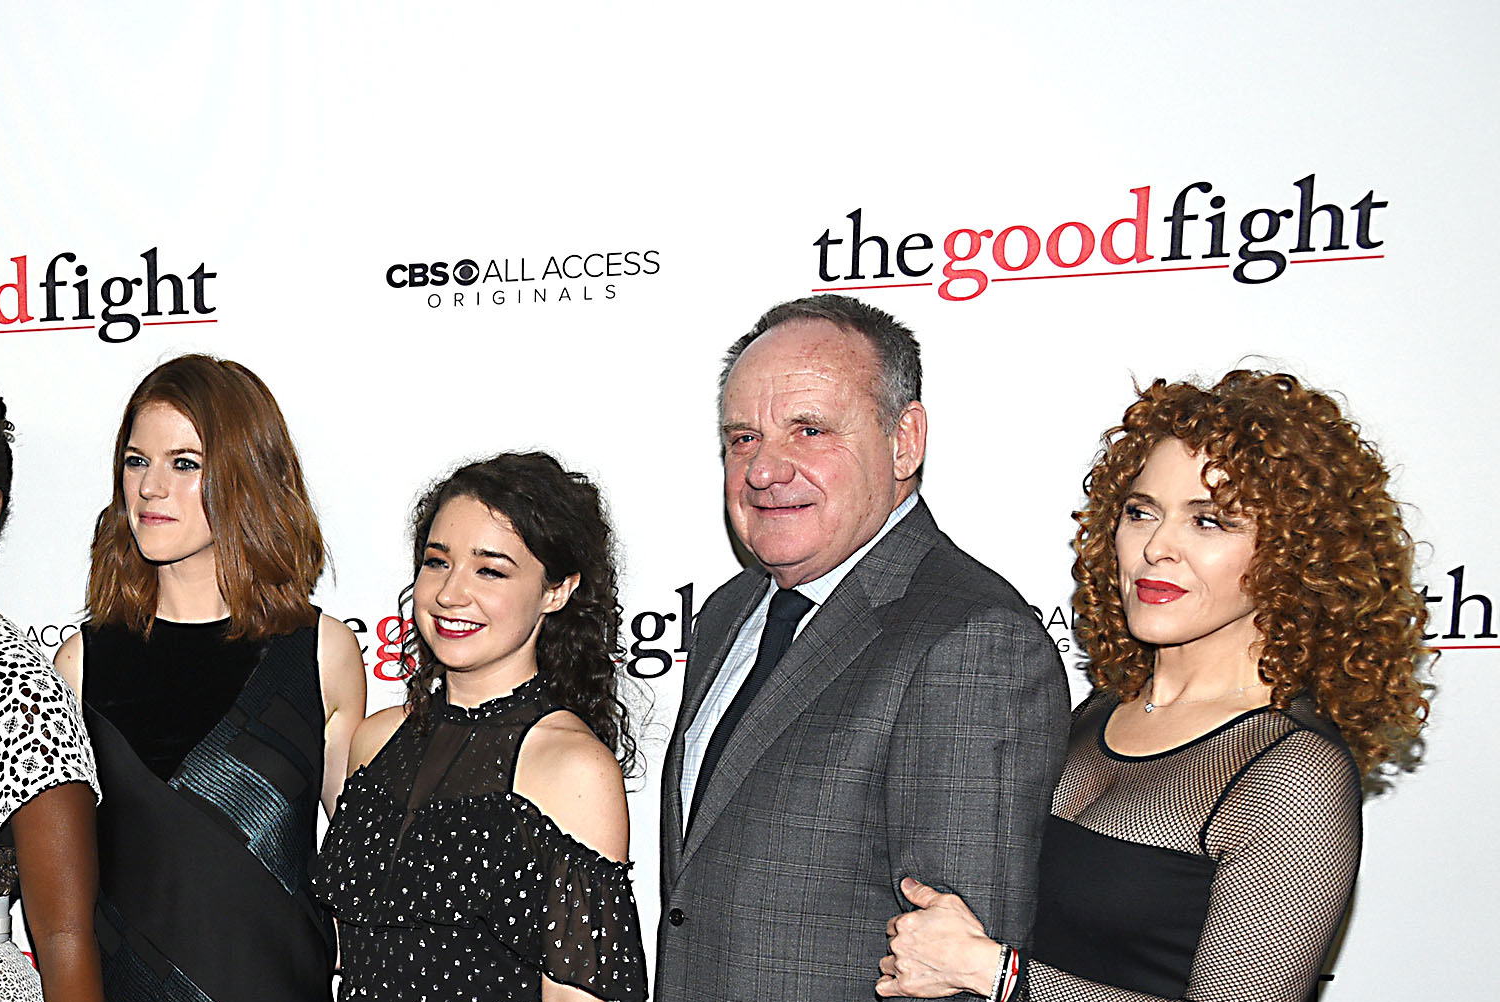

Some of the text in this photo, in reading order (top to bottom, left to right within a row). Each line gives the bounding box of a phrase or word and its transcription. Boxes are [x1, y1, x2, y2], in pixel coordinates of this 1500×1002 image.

[386, 250, 660, 288] CBS ALL ACCESS
[427, 284, 616, 308] ORIGINALS
